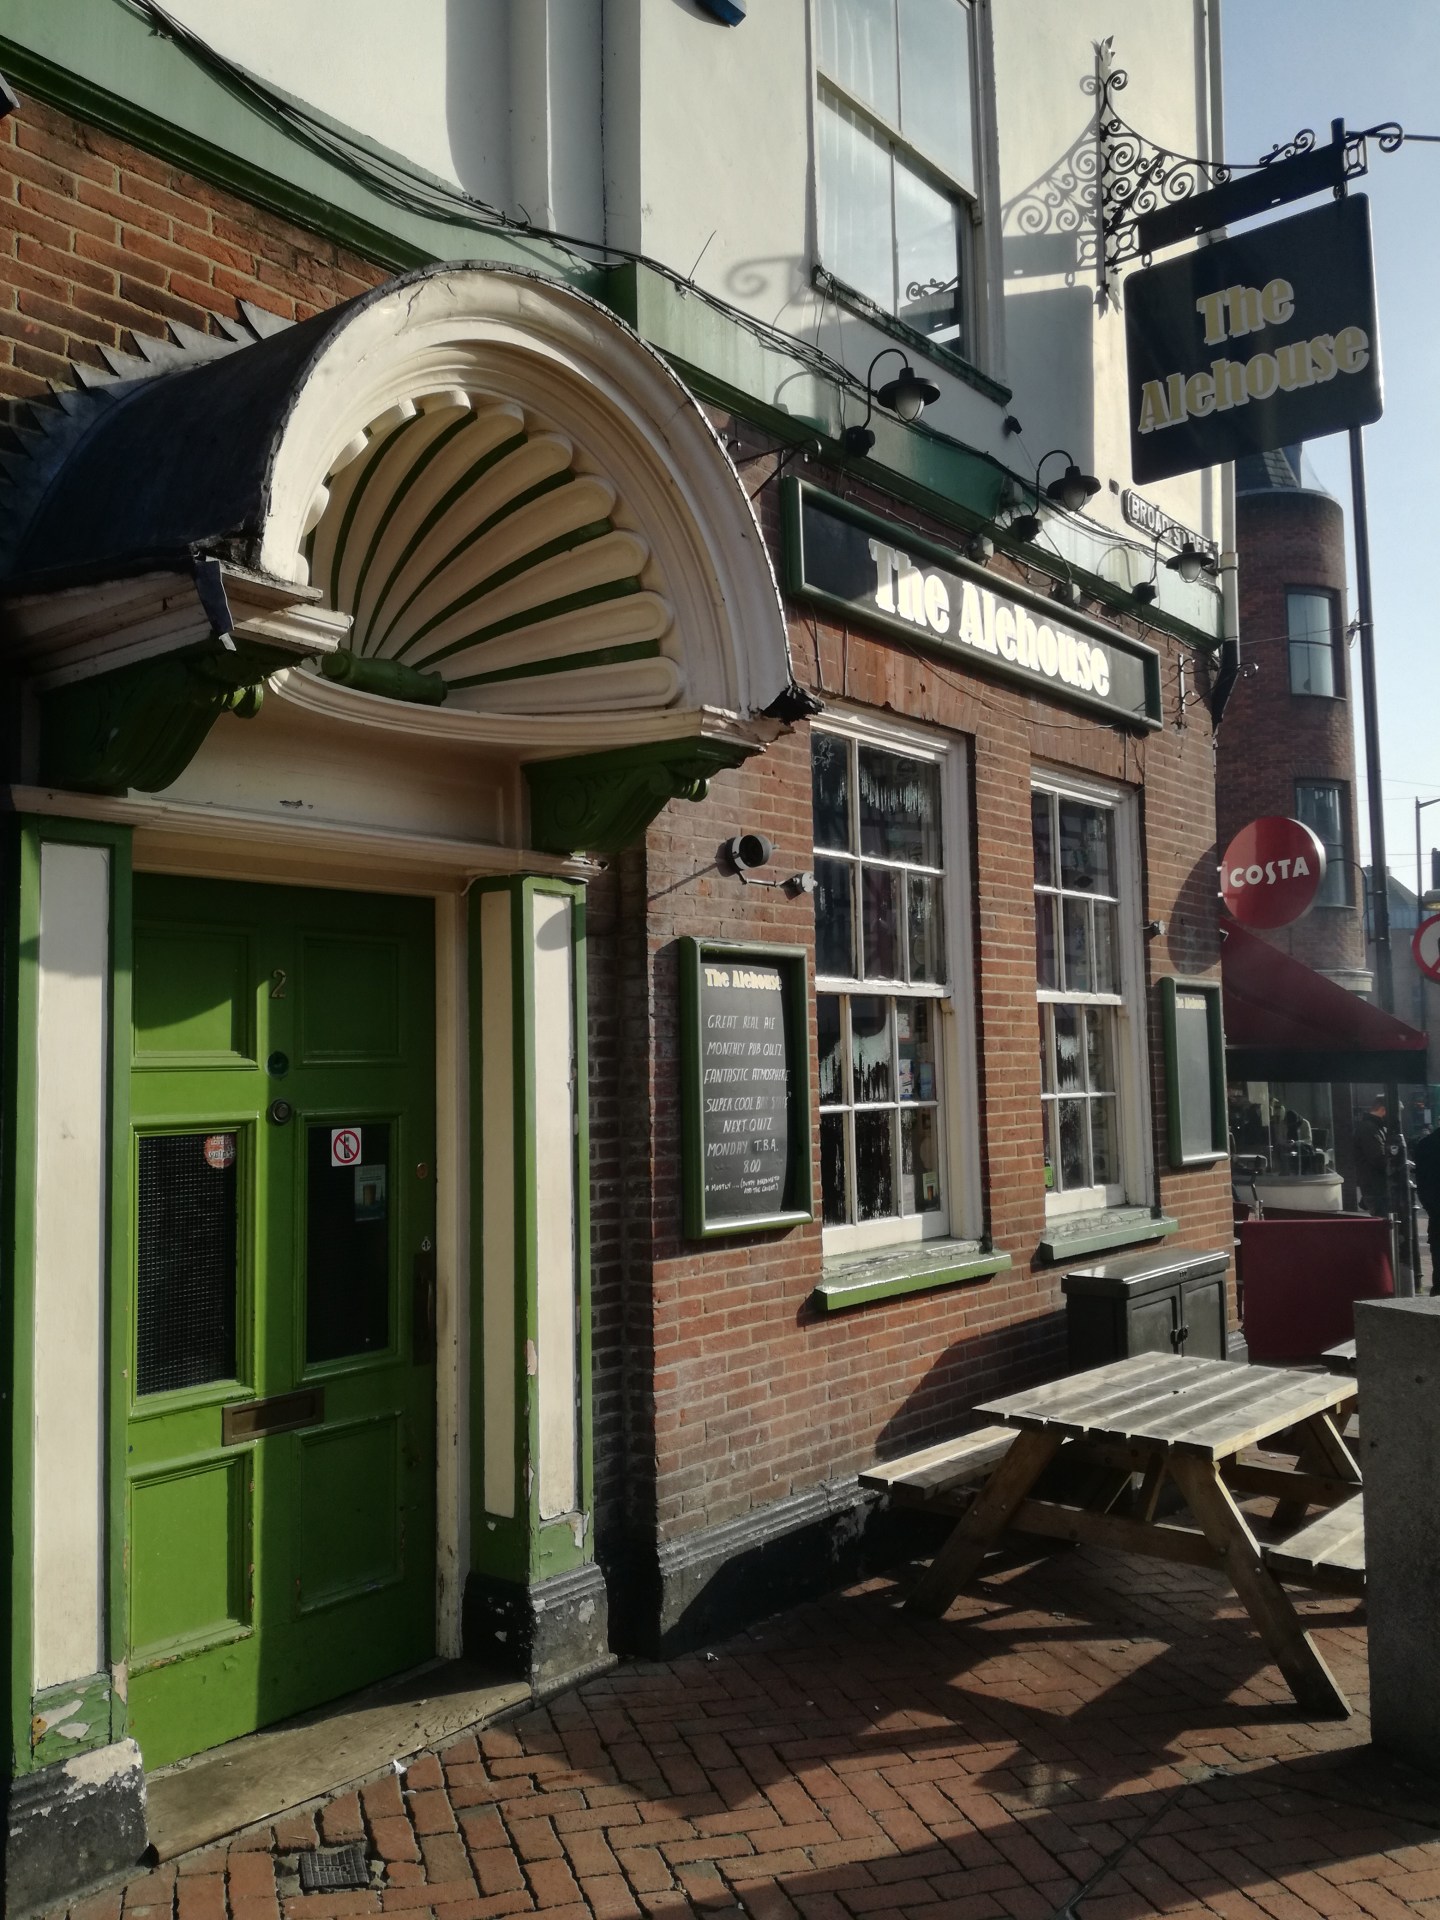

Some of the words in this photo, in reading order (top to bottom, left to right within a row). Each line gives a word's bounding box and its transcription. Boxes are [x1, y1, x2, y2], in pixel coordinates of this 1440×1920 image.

[1196, 278, 1295, 346] The
[1138, 326, 1370, 435] Alehouse
[1131, 497, 1169, 538] BROAD
[868, 537, 950, 634] The
[958, 580, 1110, 697] Alehouse
[1230, 856, 1310, 888] COSTA
[271, 968, 287, 999] 2
[704, 968, 730, 988] The
[732, 969, 783, 991] Alehouse
[707, 1014, 738, 1029] GREAT
[742, 1015, 759, 1029] REAL
[763, 1017, 776, 1030] ALE
[706, 1041, 745, 1056] MONTHLY
[747, 1041, 761, 1056] PUB
[762, 1043, 783, 1056] QUIZ
[703, 1068, 749, 1085] FANTASTIC
[751, 1067, 791, 1082] ATMOSPHERE
[704, 1098, 733, 1113] SUPER
[734, 1097, 754, 1112] COOL
[722, 1119, 748, 1134] NEXT
[748, 1117, 774, 1132] QUIZ
[706, 1141, 748, 1157] MONDAY
